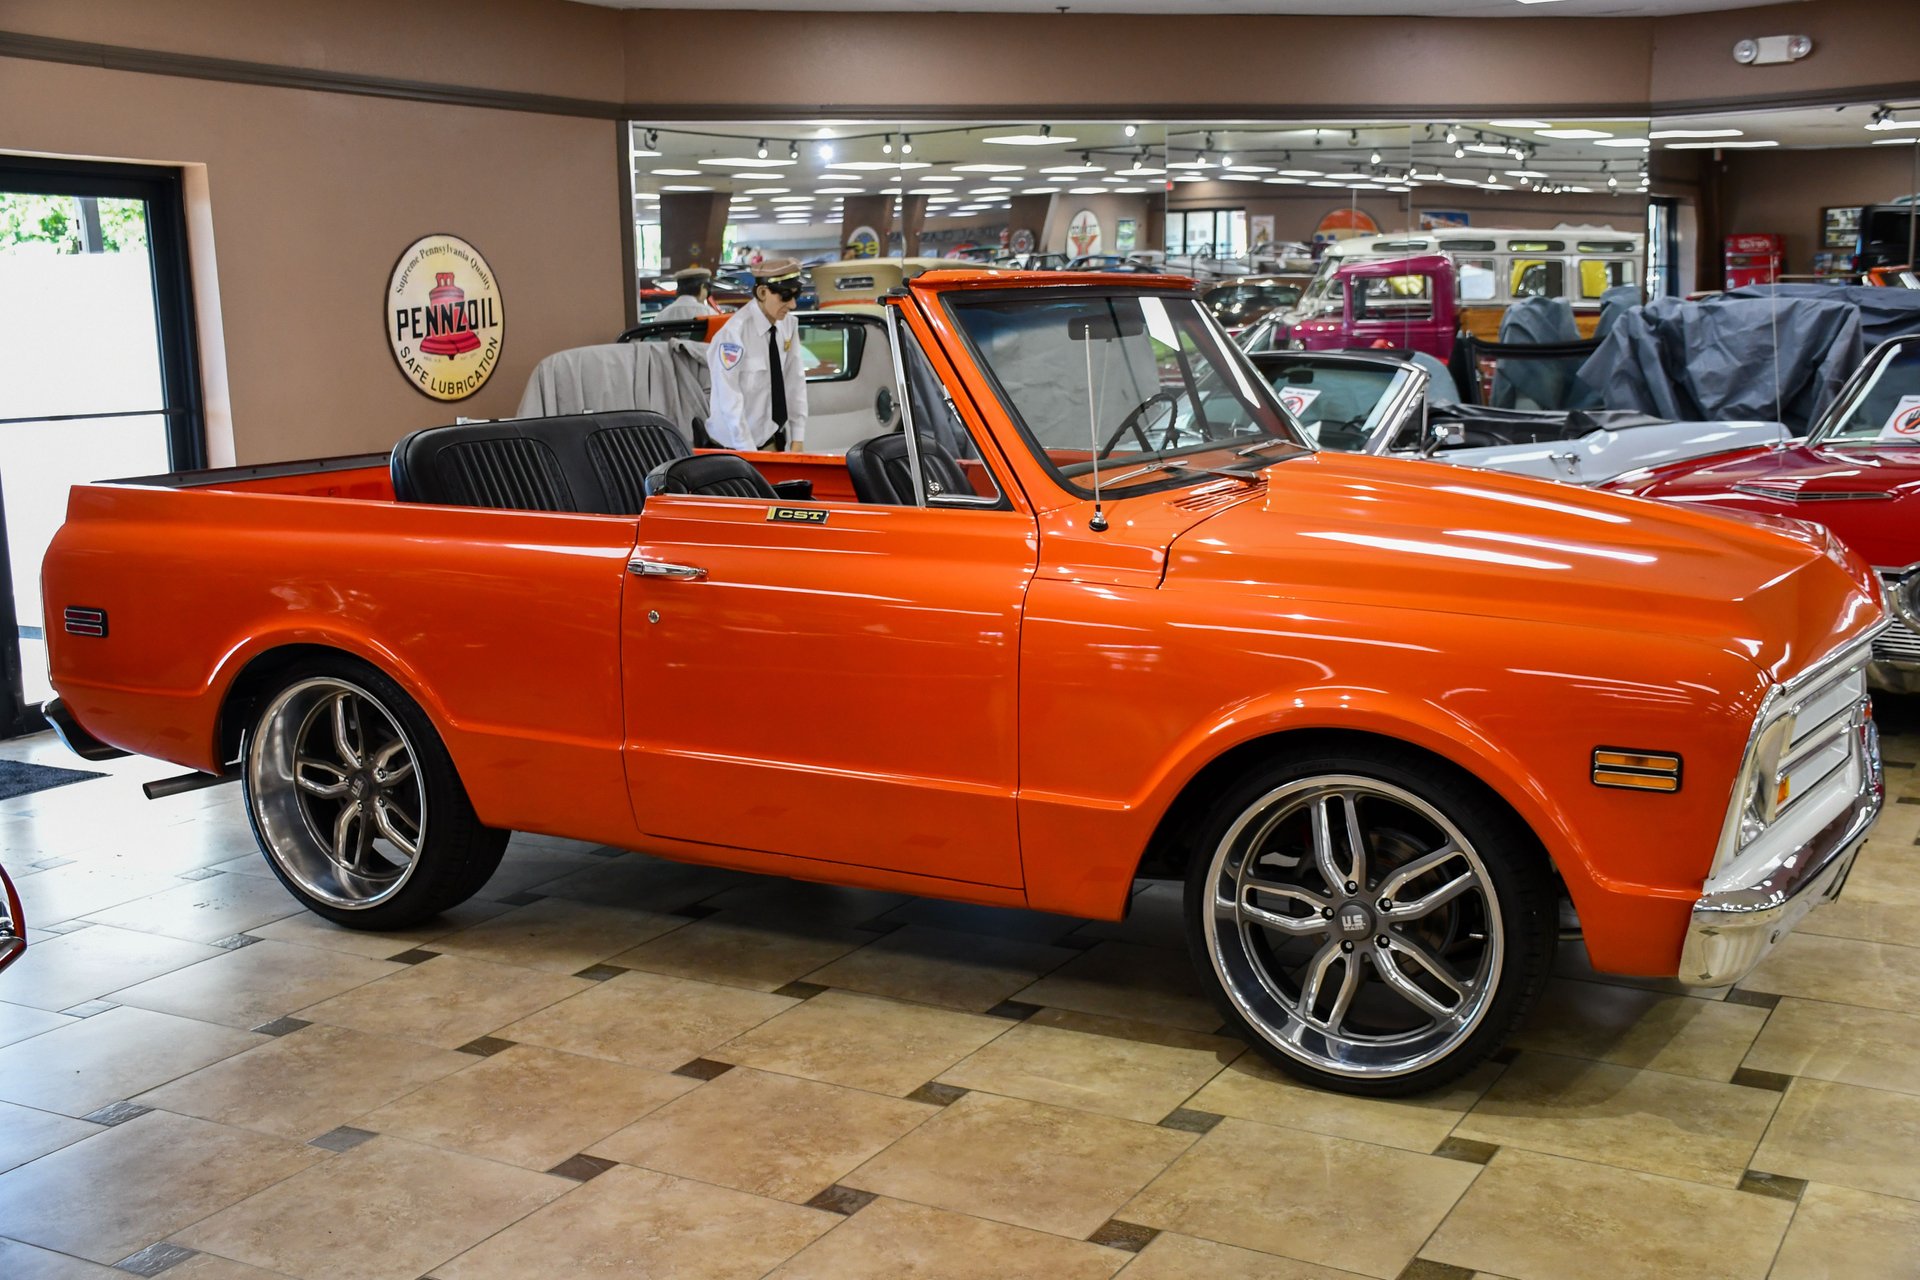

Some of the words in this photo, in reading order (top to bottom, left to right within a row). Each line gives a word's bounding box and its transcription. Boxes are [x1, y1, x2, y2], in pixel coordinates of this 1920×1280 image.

[396, 256, 420, 296] Supreme
[419, 243, 470, 262] Pennsylvania
[470, 257, 492, 291] Quality
[396, 297, 498, 342] PENNZOIL
[400, 345, 429, 385] SAFE
[430, 336, 498, 395] LUBRICATION
[778, 510, 824, 520] CST
